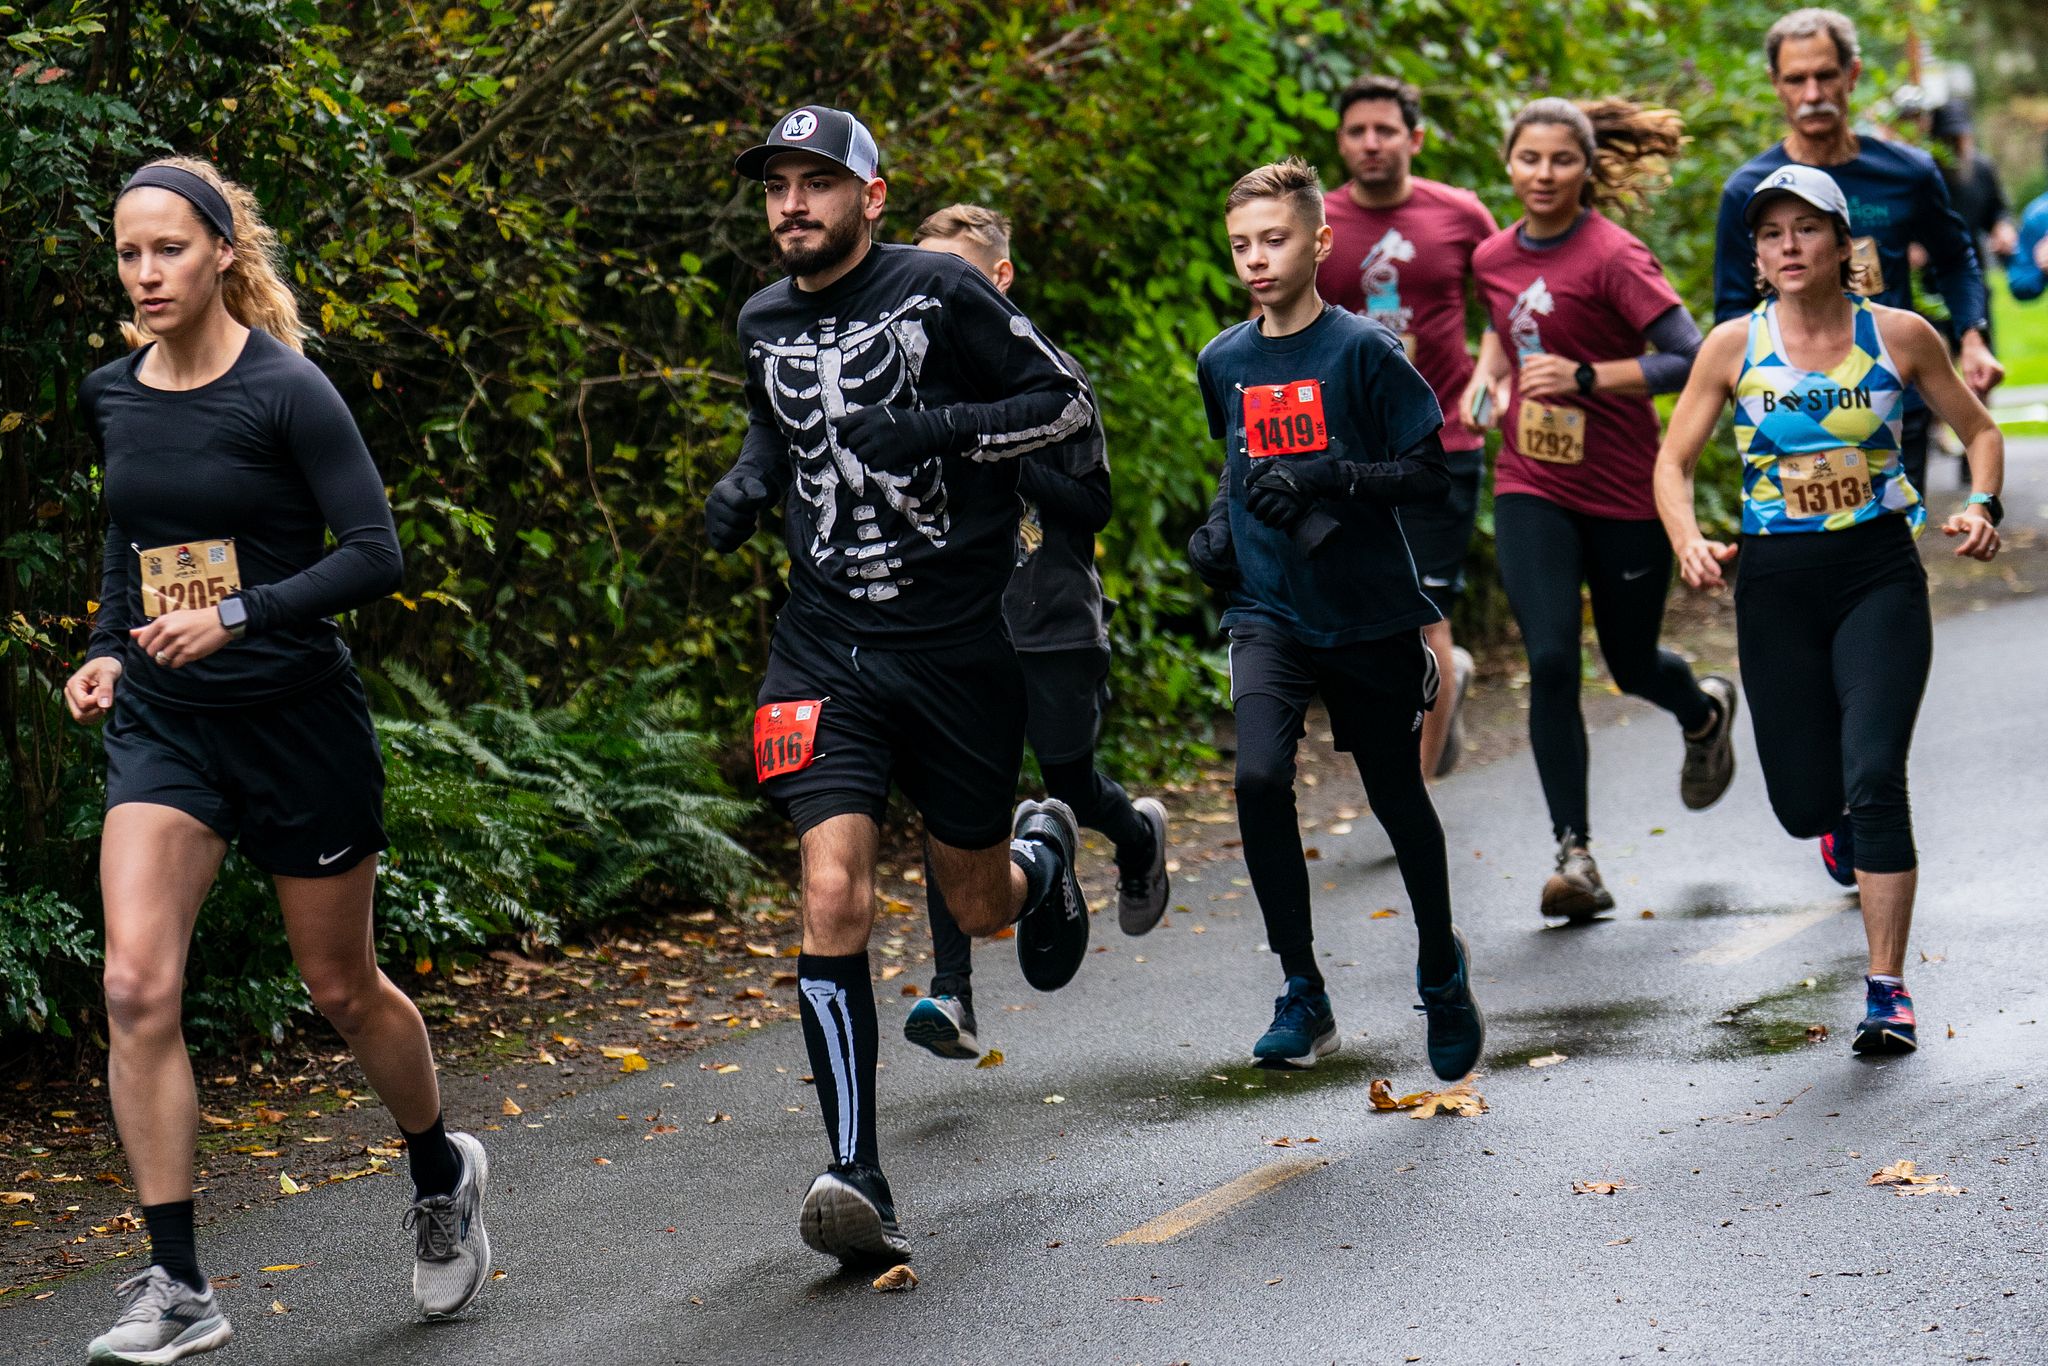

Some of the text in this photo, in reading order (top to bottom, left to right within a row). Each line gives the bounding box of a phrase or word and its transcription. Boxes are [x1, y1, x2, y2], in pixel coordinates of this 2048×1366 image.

[1763, 386, 1872, 413] BSTON
[1255, 413, 1315, 451] 1419
[1526, 430, 1574, 459] 1292
[1793, 477, 1861, 513] 1313
[154, 577, 227, 616] 1205
[756, 732, 803, 776] 1416
